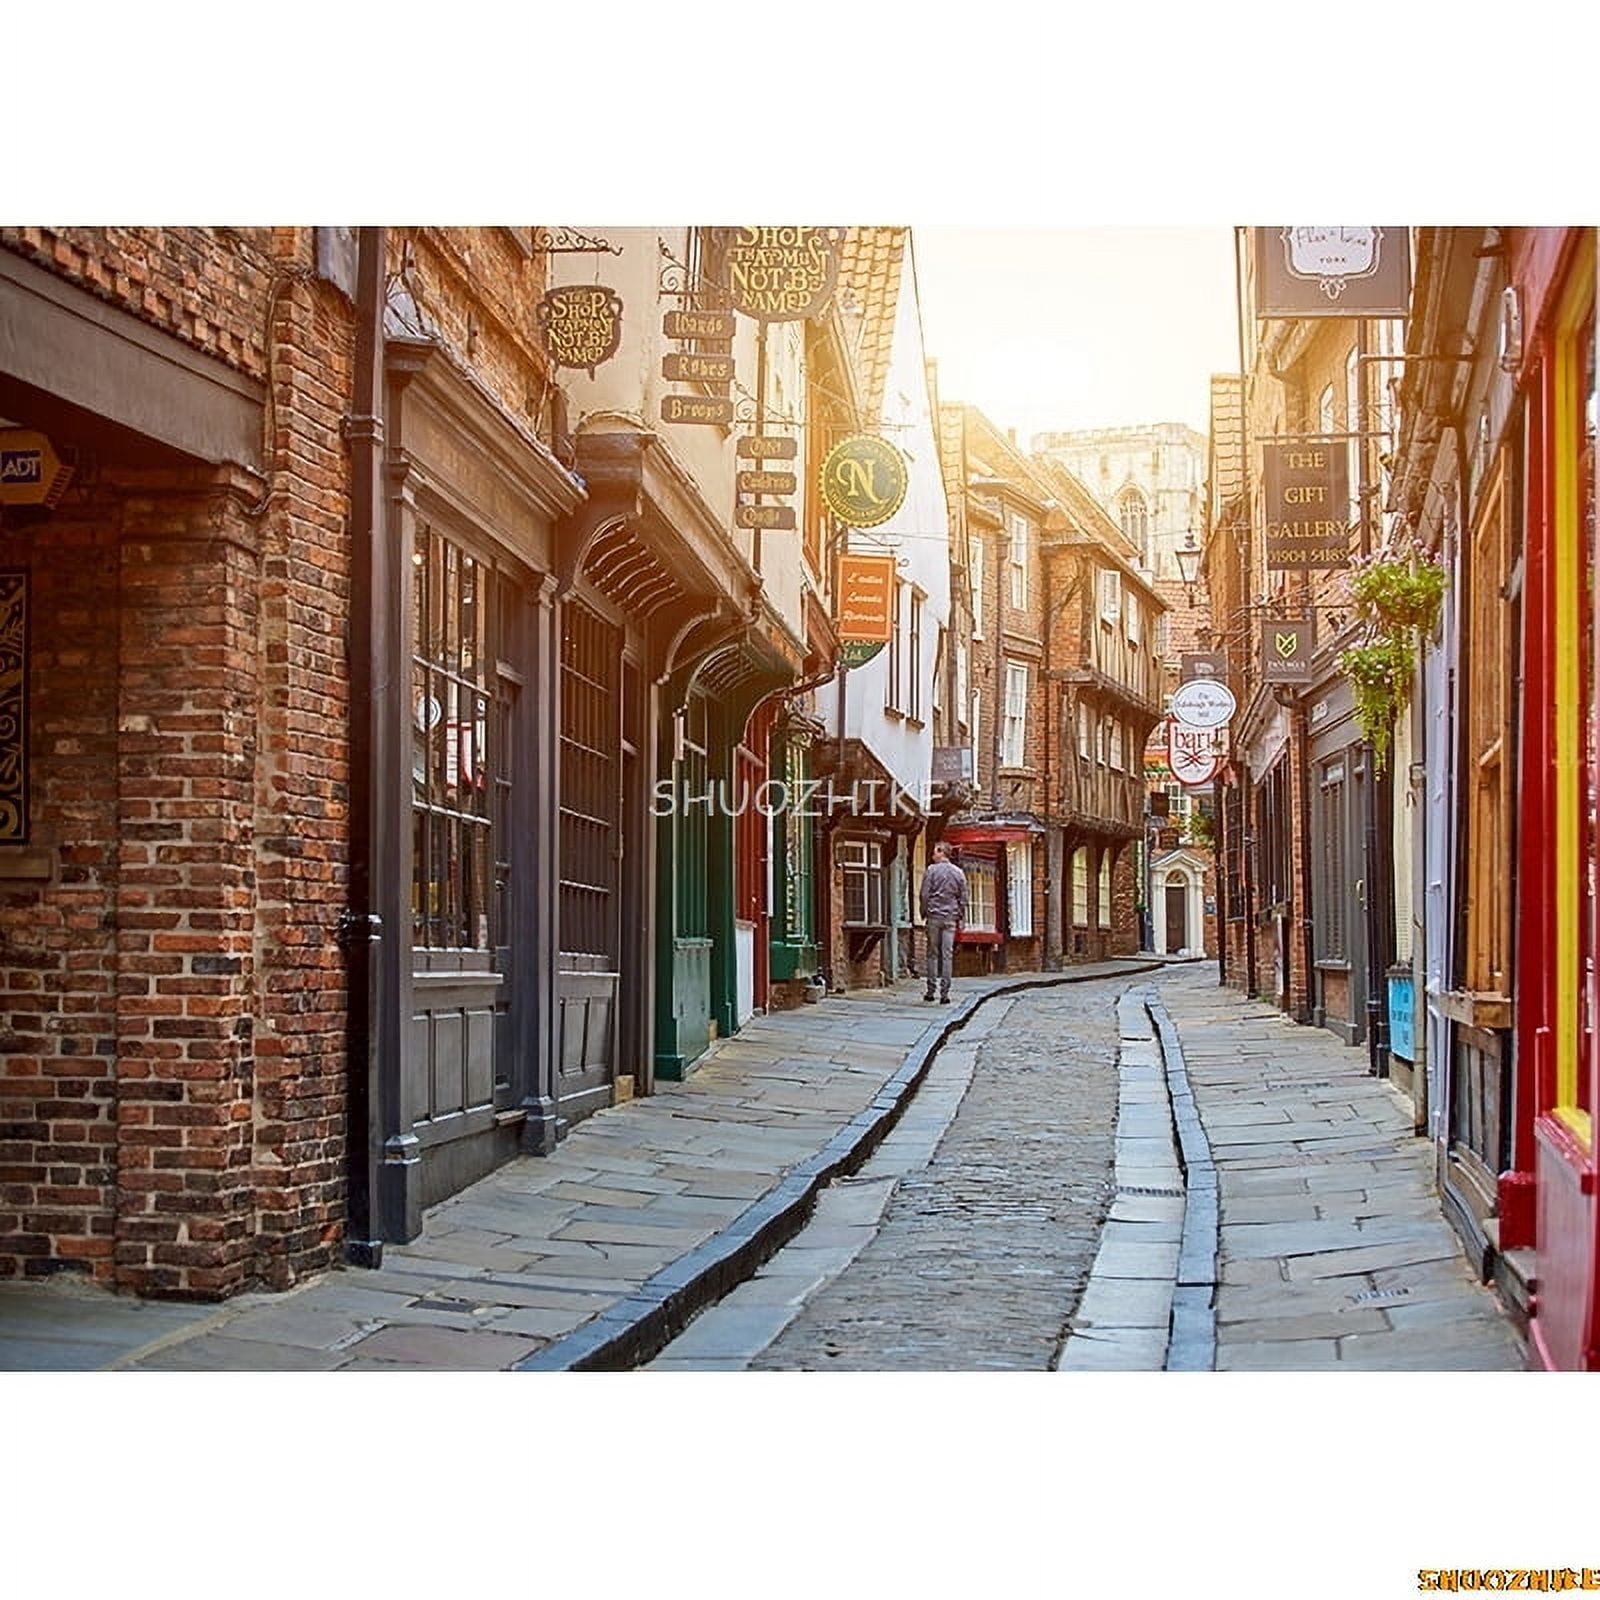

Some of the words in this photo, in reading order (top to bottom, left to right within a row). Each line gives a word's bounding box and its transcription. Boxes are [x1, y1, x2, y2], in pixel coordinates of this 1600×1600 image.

[728, 261, 785, 295] NOT
[552, 293, 607, 318] SHOP
[1, 458, 41, 477] ADT
[1284, 452, 1326, 469] THE
[1284, 486, 1328, 504] GIFT
[1267, 520, 1348, 538] GALLERY
